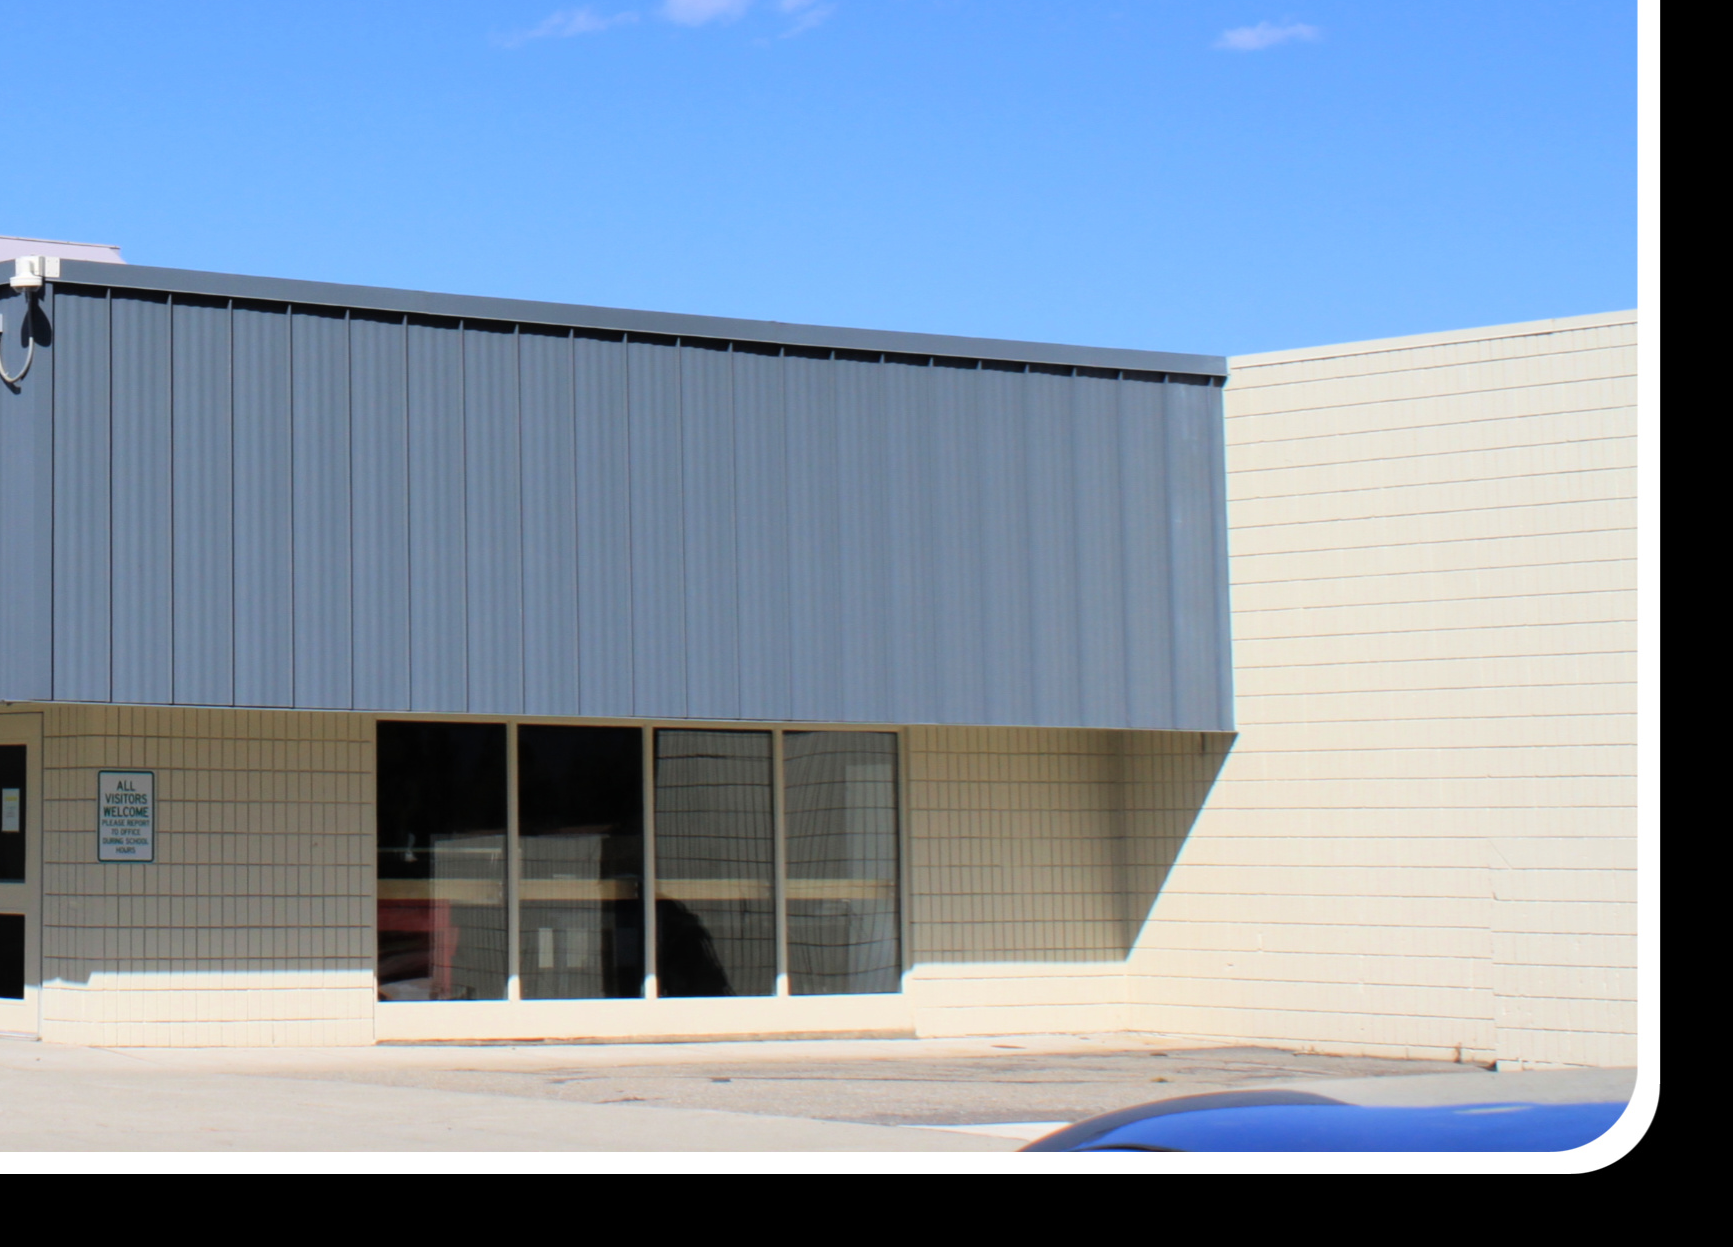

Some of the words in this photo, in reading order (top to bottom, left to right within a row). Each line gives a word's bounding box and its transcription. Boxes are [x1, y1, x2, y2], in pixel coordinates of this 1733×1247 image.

[116, 780, 135, 791] ALL
[105, 793, 147, 804] VISITORS
[103, 806, 149, 817] WELCOME
